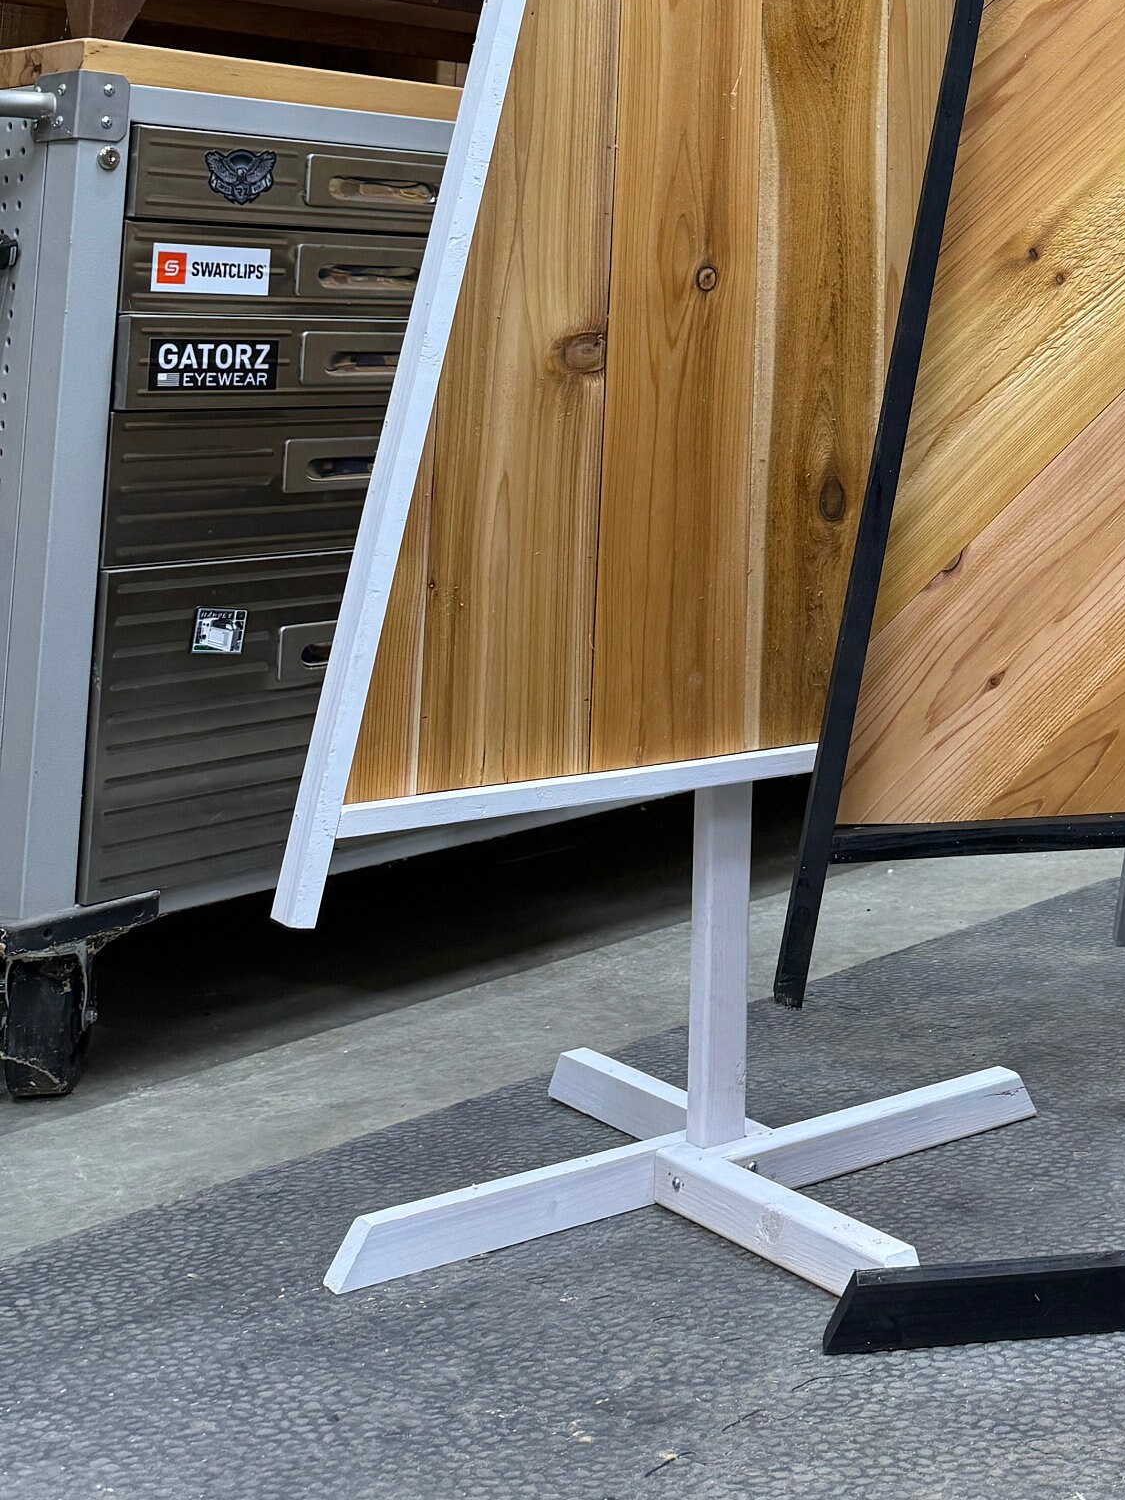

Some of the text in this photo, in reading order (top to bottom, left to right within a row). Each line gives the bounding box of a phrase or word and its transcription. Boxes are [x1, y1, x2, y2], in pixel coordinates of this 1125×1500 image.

[191, 261, 264, 279] SWATCLIPS
[158, 343, 271, 370] GATORZ
[183, 372, 268, 386] EYEWEAR
